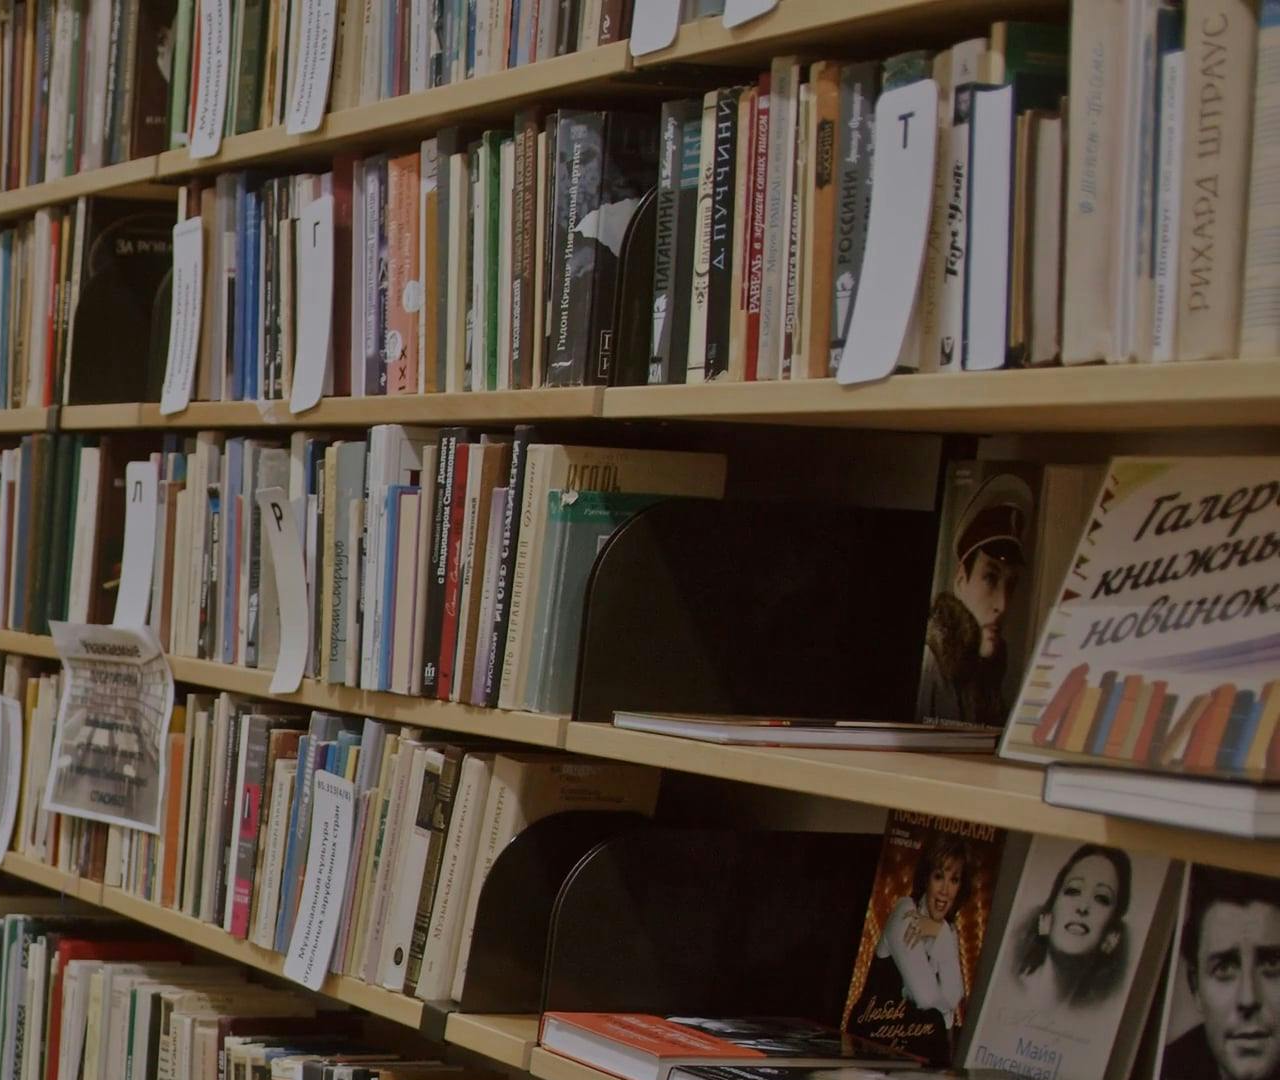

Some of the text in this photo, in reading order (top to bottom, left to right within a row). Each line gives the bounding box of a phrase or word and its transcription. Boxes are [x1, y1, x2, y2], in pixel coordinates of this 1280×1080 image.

[758, 115, 768, 154] писем
[898, 111, 914, 150] Т
[712, 97, 732, 270] Д. ПУЧЧИНИ
[756, 155, 767, 190] своих
[1188, 13, 1230, 314] РИХАРД ШТРАУС
[312, 221, 320, 248] Г
[654, 190, 676, 292] ПАГАНИНИ
[753, 192, 766, 240] зеркале
[837, 170, 859, 266] РОССИНИ
[749, 254, 762, 314] РАВЕЛЬ
[437, 437, 448, 484] Диалоги
[442, 436, 456, 504] Спиваковым
[269, 501, 283, 532] Р
[437, 506, 452, 576] Владимиром
[465, 497, 477, 559] Стравинский
[1133, 480, 1280, 543] Галер
[296, 821, 331, 960] Музыкальная культура
[302, 804, 341, 983] отдельных зарубежных стран
[1015, 1037, 1057, 1065] Майя
